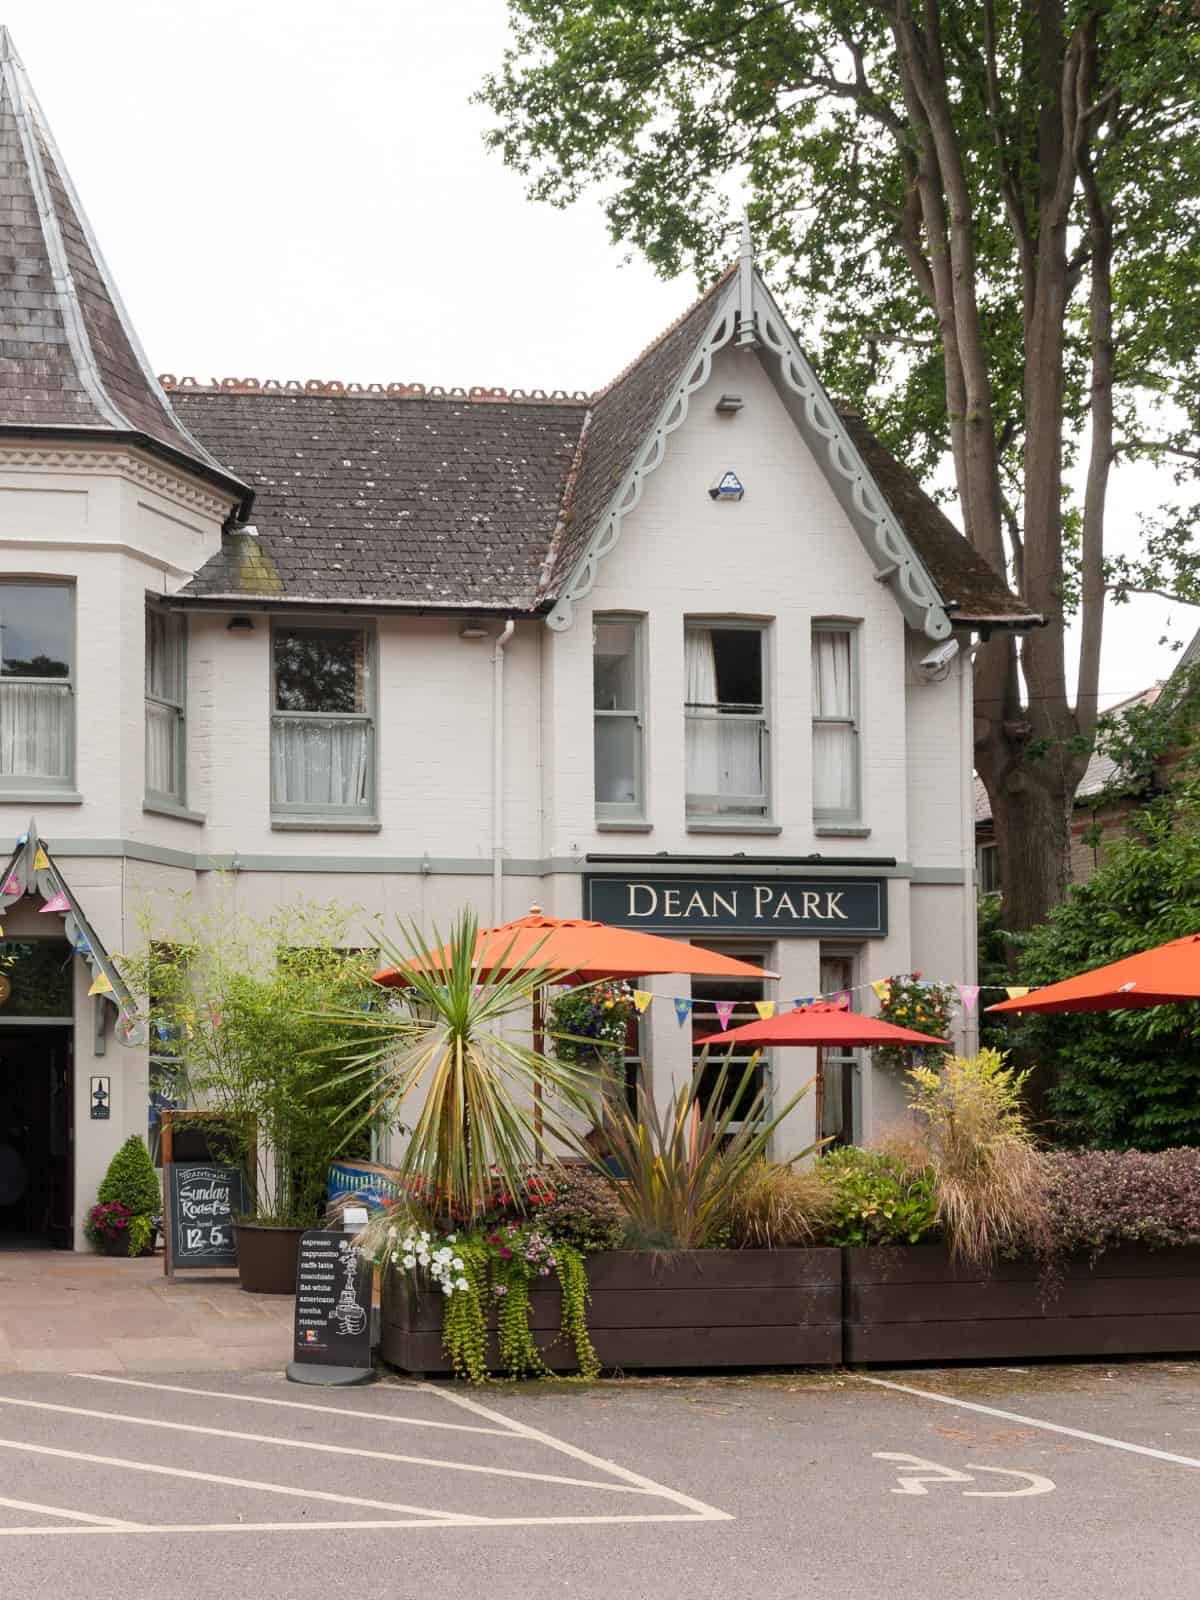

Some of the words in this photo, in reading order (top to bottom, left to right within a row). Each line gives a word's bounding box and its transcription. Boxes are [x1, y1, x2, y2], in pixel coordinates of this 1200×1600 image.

[626, 884, 739, 918] DEAN
[752, 886, 849, 920] PARK
[179, 1181, 230, 1203] Sunday
[181, 1200, 231, 1219] Roasts
[302, 1239, 331, 1247] espresso
